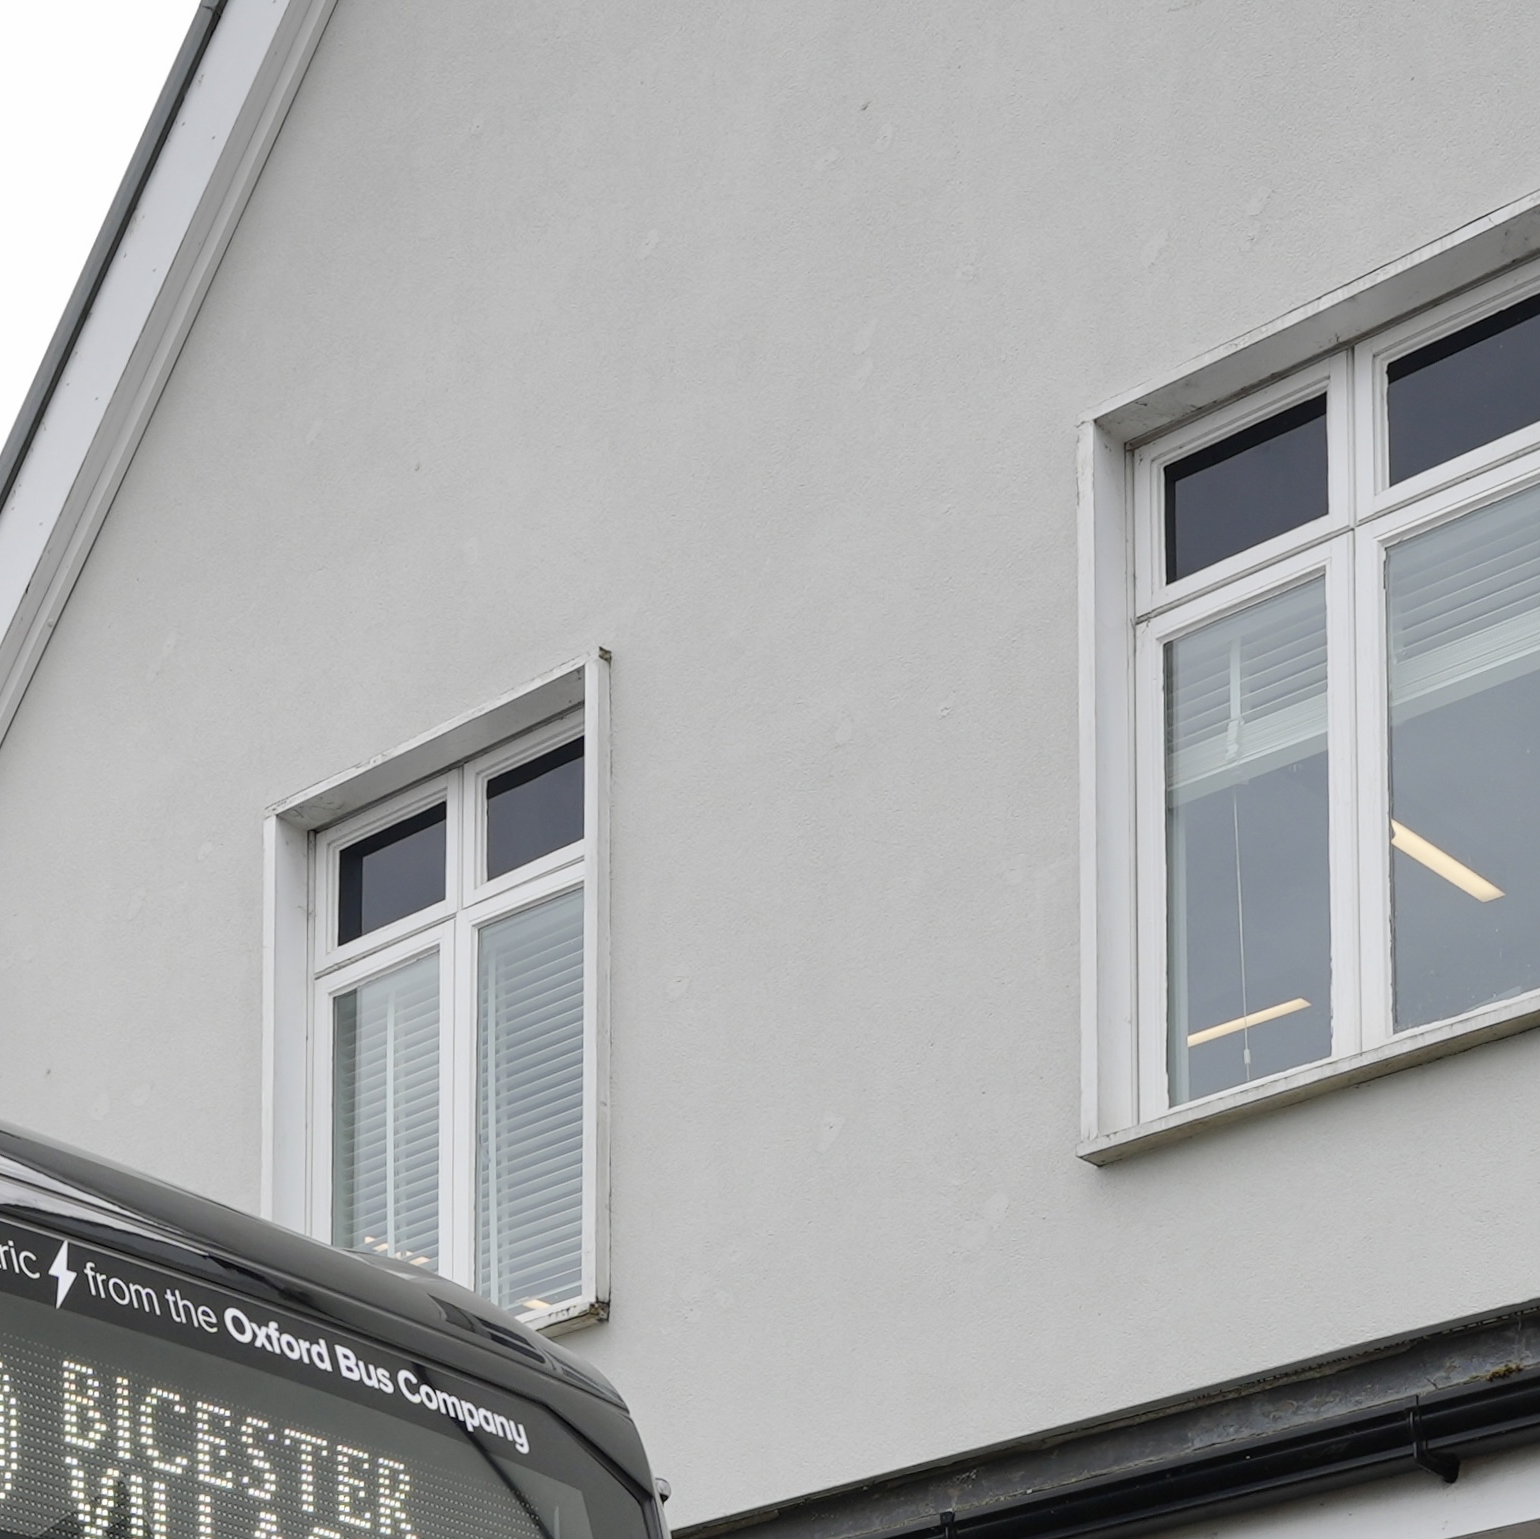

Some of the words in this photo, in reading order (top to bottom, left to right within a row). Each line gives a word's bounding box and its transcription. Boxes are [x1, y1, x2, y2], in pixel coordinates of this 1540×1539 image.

[84, 1261, 166, 1316] from
[166, 1288, 219, 1334] the
[224, 1307, 333, 1373] Oxford
[334, 1343, 395, 1395] Bus
[397, 1369, 530, 1455] Company
